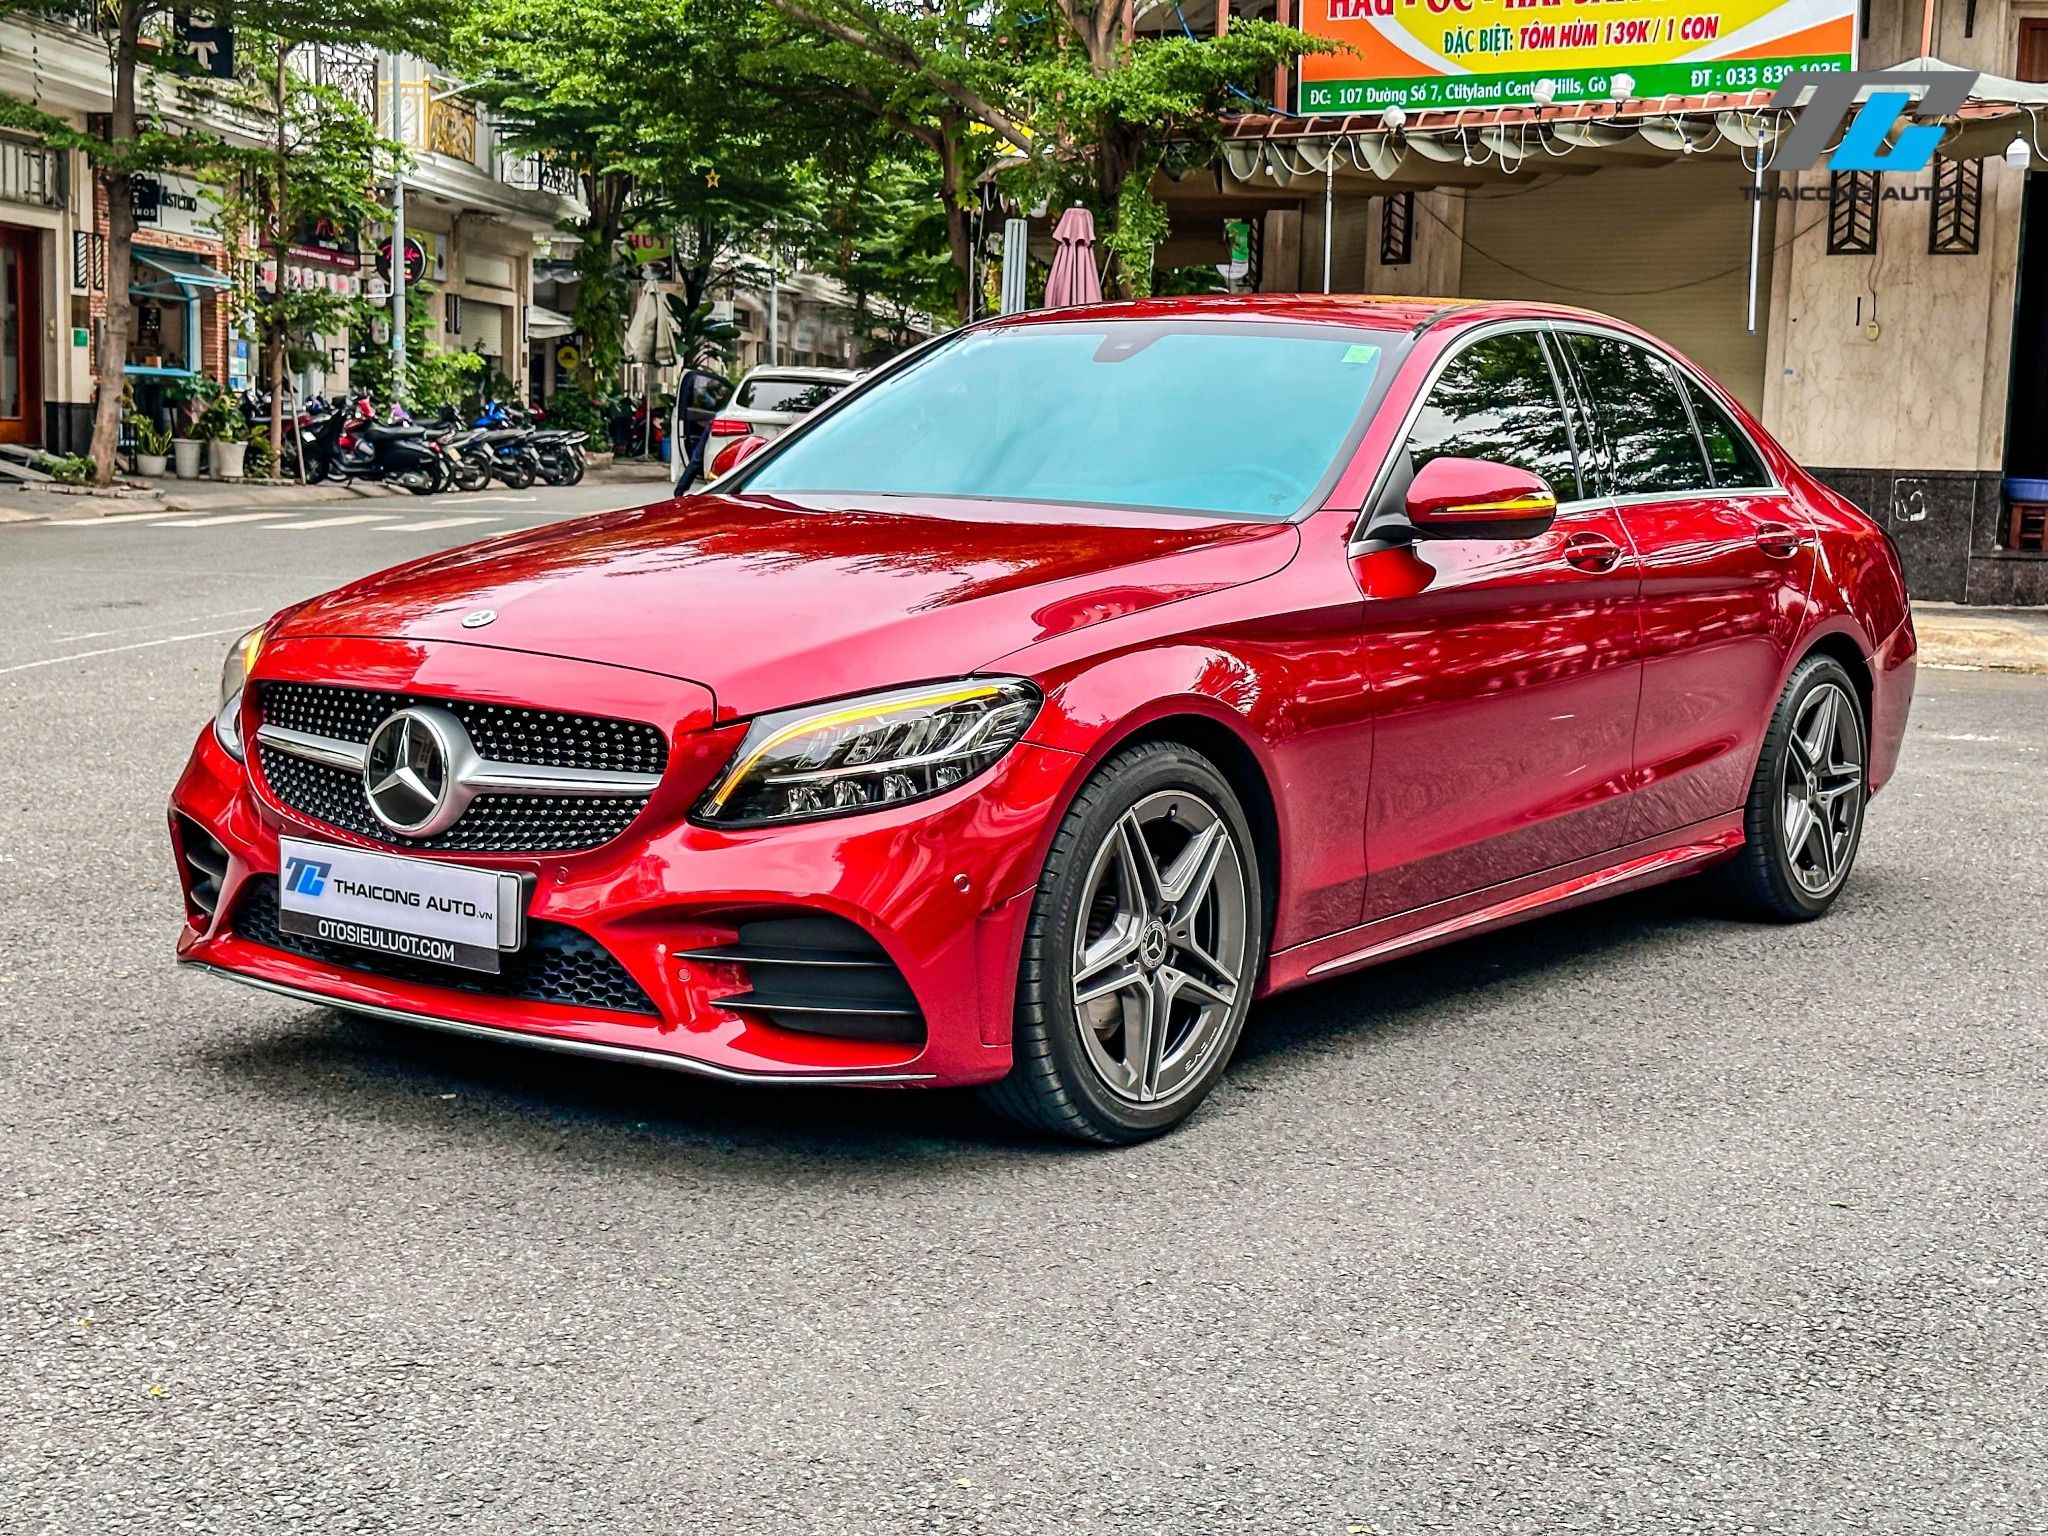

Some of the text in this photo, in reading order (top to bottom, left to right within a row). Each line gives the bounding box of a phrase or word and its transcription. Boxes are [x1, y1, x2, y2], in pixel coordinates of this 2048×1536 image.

[1444, 26, 1474, 58] ĐẶC
[1479, 23, 1513, 57] BIỆT:
[1520, 20, 1555, 50] TÔM
[1605, 20, 1650, 45] 139K
[1667, 18, 1674, 41] 1
[1681, 16, 1718, 40] CON
[1310, 90, 1331, 104] ĐC:
[1339, 88, 1362, 104] 107
[1367, 87, 1407, 105] Đường
[1411, 83, 1426, 101] Số
[1431, 85, 1441, 102] 7,
[1588, 76, 1606, 92] Gò
[1691, 69, 1712, 87] ĐT
[1726, 67, 1757, 85] 033
[334, 879, 420, 907] THAICONG
[318, 919, 455, 962] OTOSIEULUOT.COM
